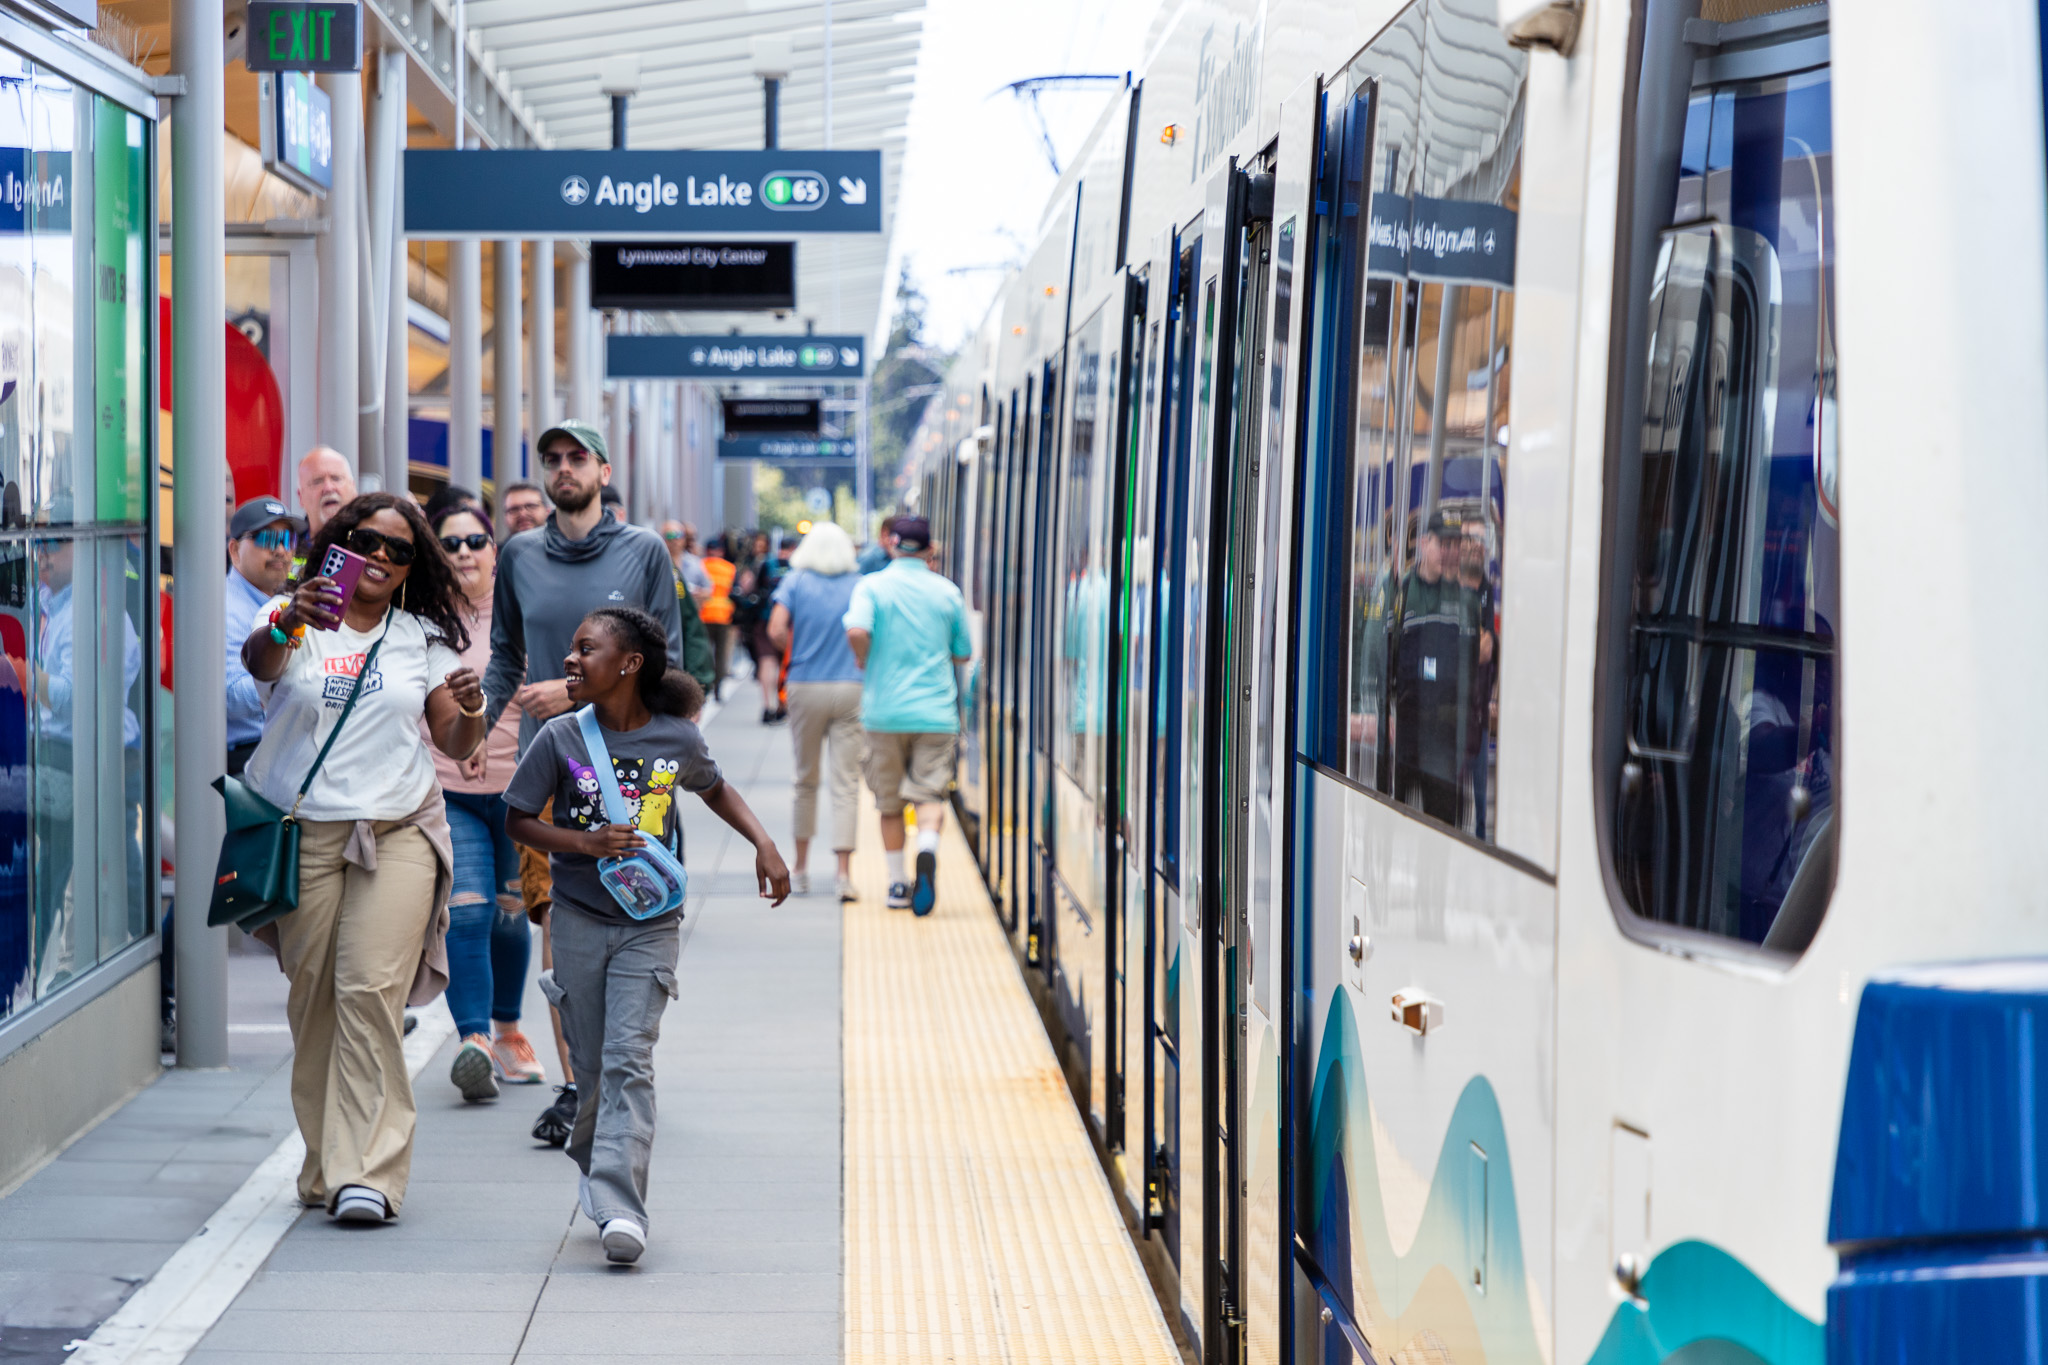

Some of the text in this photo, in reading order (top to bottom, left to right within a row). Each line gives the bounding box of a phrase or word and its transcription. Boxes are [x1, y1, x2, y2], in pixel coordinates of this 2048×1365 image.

[268, 8, 336, 61] EXIT
[594, 172, 679, 214] Angle
[686, 173, 753, 206] Lake
[791, 179, 820, 203] 65
[617, 246, 767, 269] Lynnwood City Center
